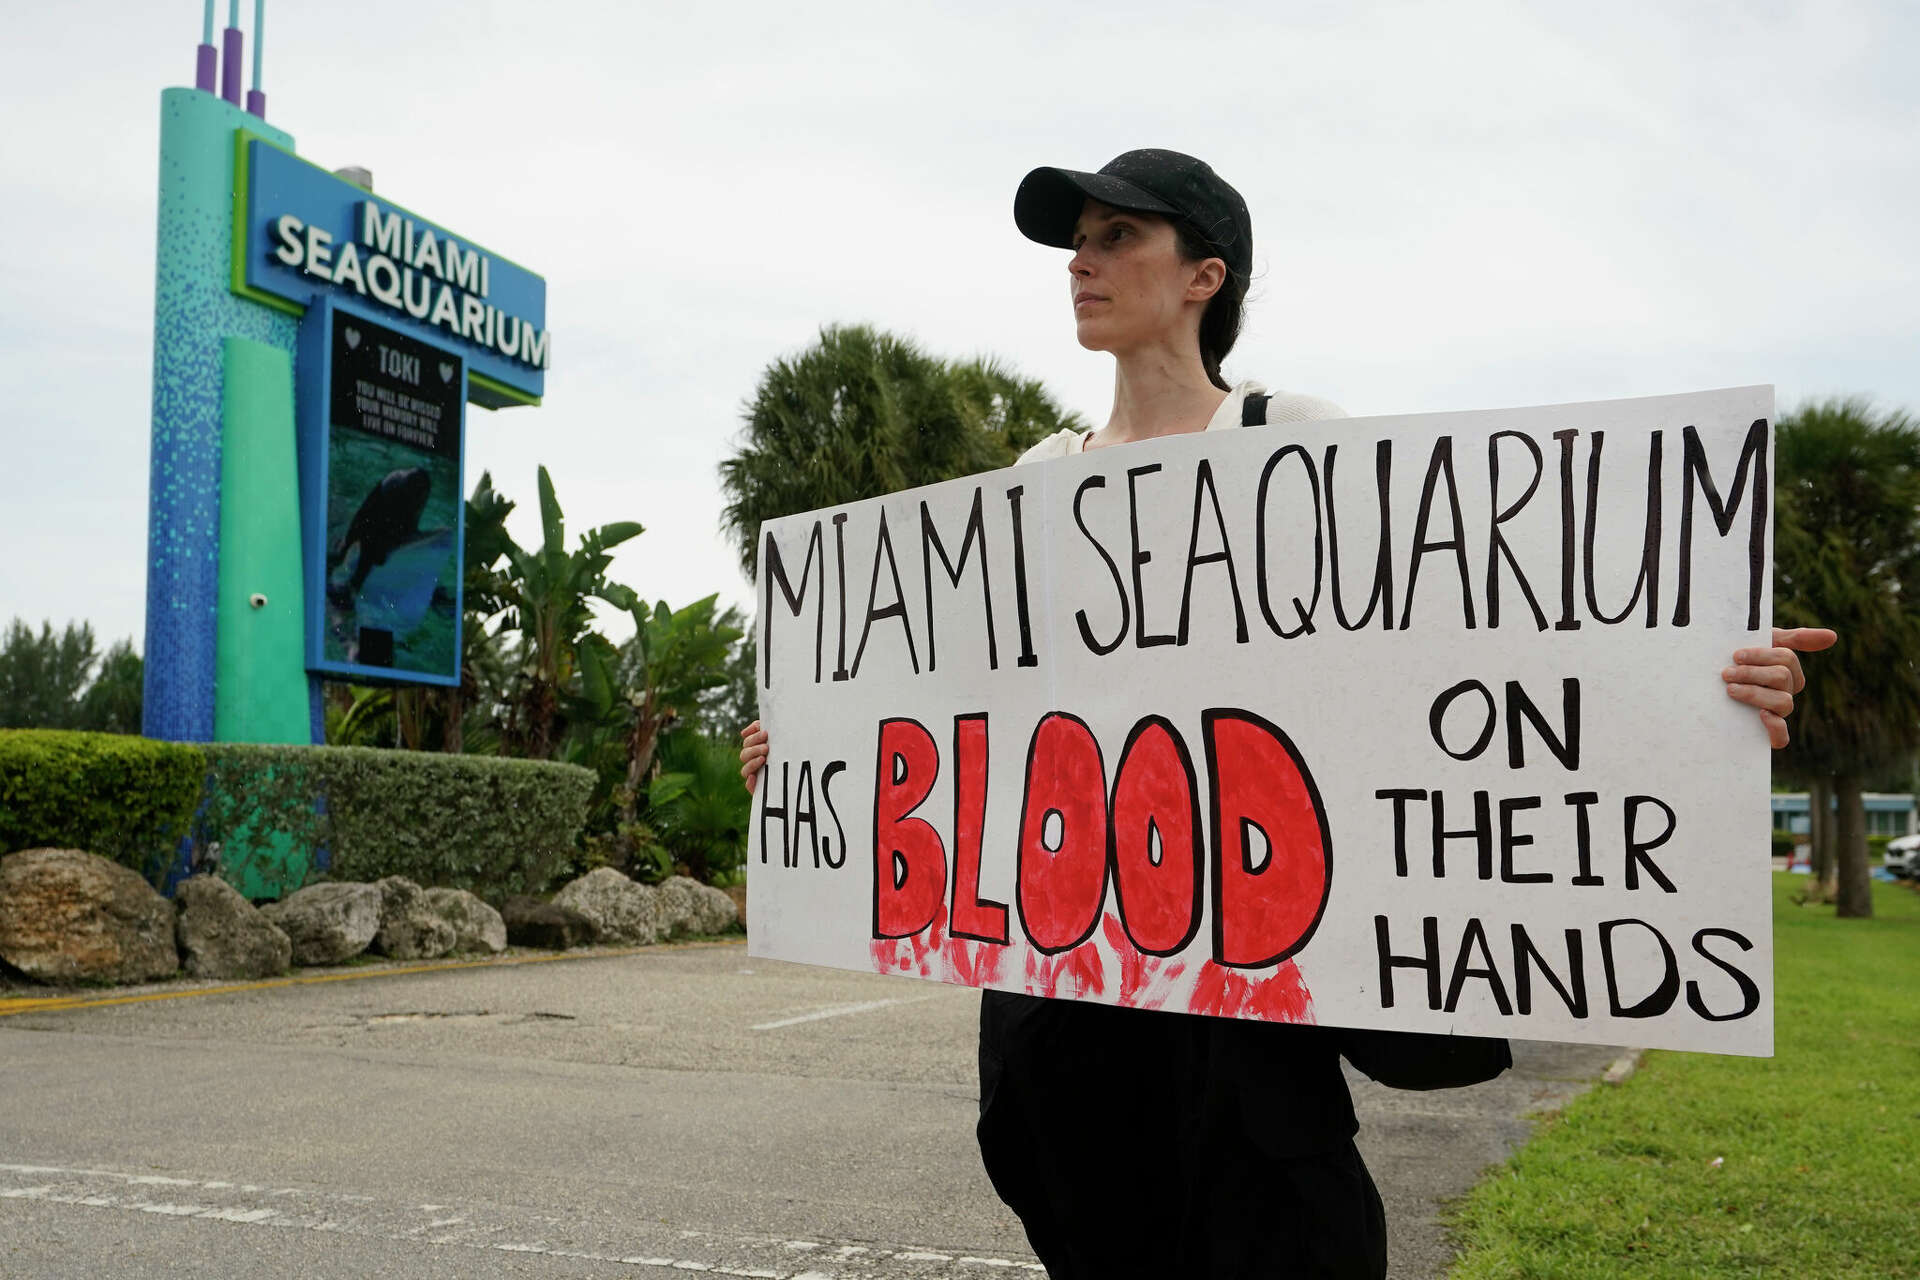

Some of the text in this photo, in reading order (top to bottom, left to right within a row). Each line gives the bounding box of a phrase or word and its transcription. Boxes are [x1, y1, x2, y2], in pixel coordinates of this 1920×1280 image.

[276, 214, 551, 370] SEAQUARIUM
[364, 201, 489, 297] MIAMI
[379, 345, 420, 386] TOKI
[765, 418, 1768, 689] MIAMI SEAQUARIUM
[1429, 678, 1581, 771] ON
[760, 708, 1334, 969] HAS BLOOD
[1375, 789, 1678, 894] THEIR
[1374, 914, 1761, 1022] HANDS
